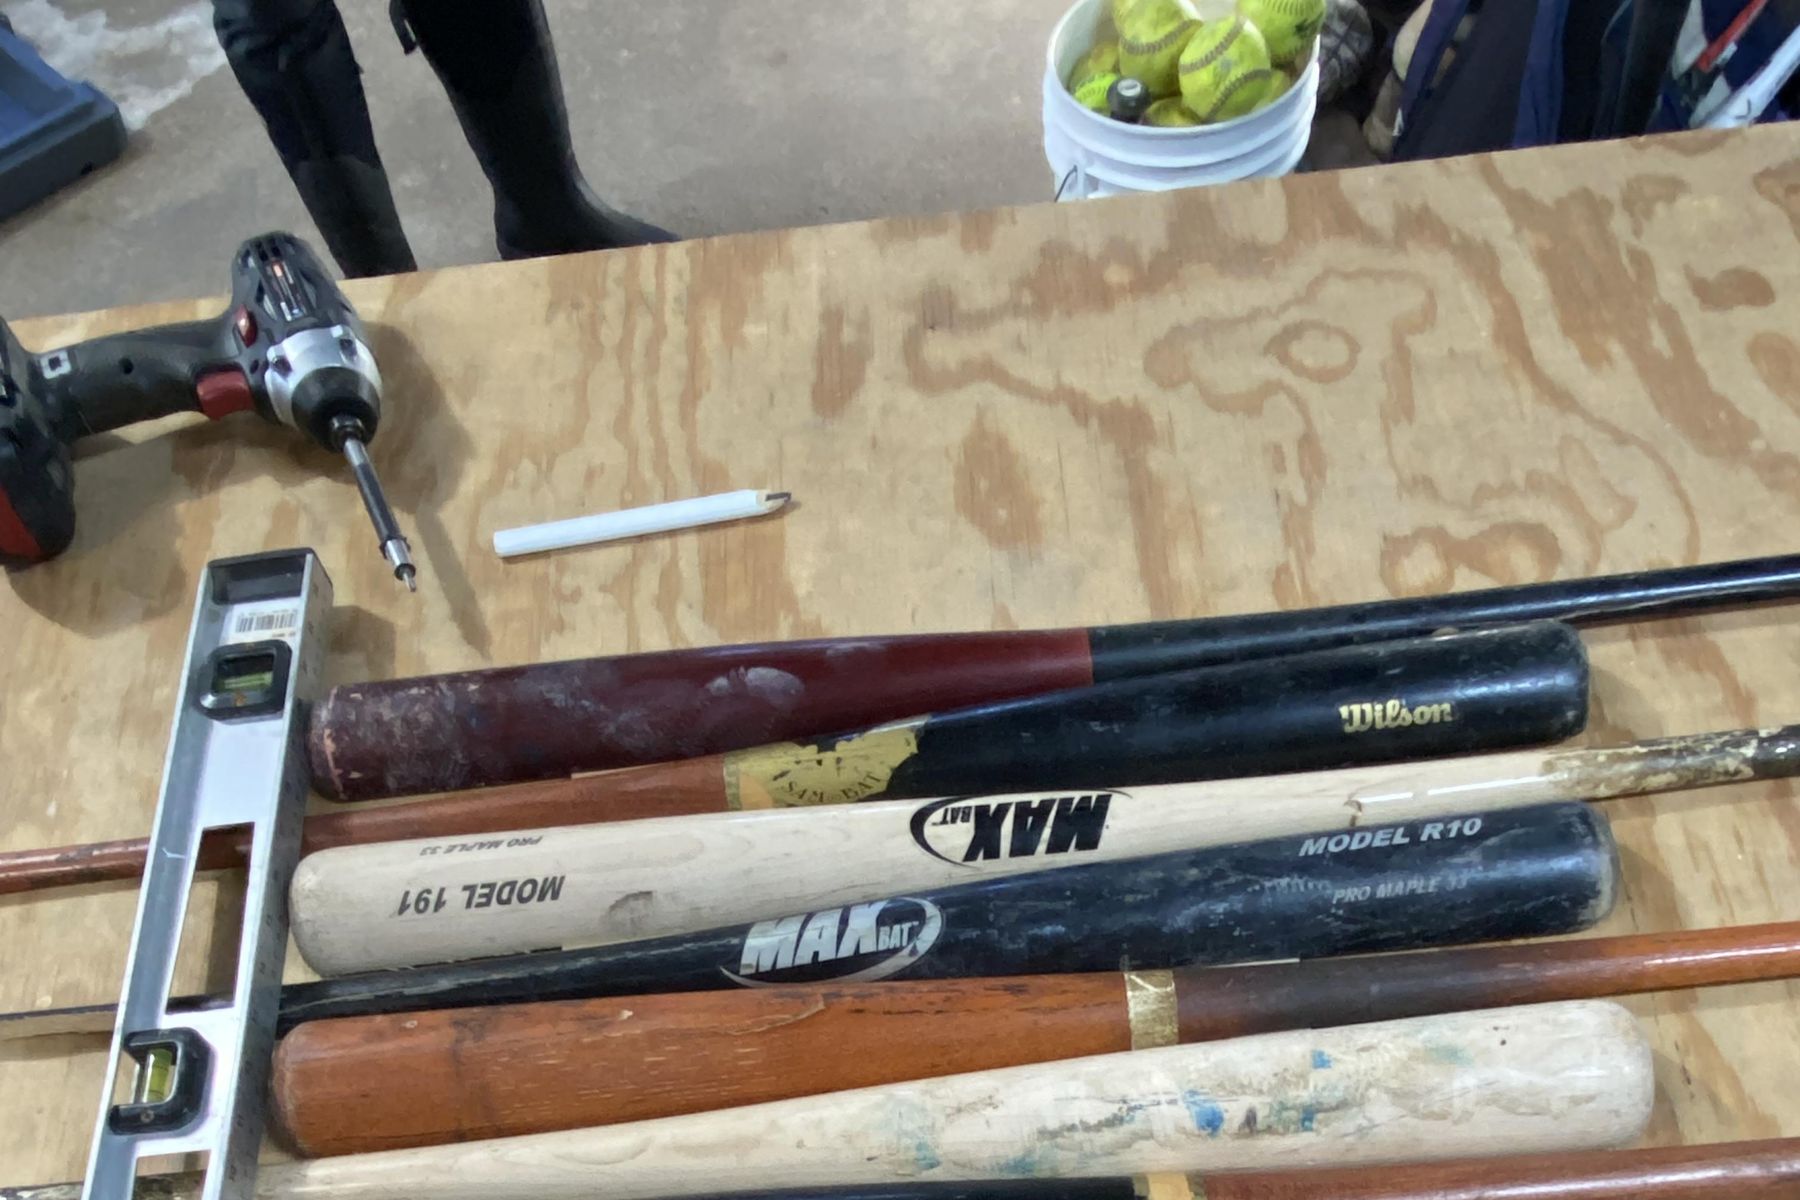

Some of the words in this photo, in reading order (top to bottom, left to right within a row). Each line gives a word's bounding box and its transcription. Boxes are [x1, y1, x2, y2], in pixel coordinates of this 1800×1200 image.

[1338, 698, 1453, 733] Wilson
[942, 806, 974, 825] BAT
[962, 794, 1112, 863] MAX
[443, 840, 503, 854] MAPLE
[506, 836, 543, 848] PRO
[1299, 827, 1410, 857] MODEL
[1420, 817, 1482, 842] R10
[397, 887, 447, 917] 191
[461, 875, 566, 910] MODEL
[1332, 886, 1371, 904] PRO
[1376, 876, 1440, 899] MAPLE
[740, 900, 889, 975] MAX
[878, 923, 912, 949] BAT
